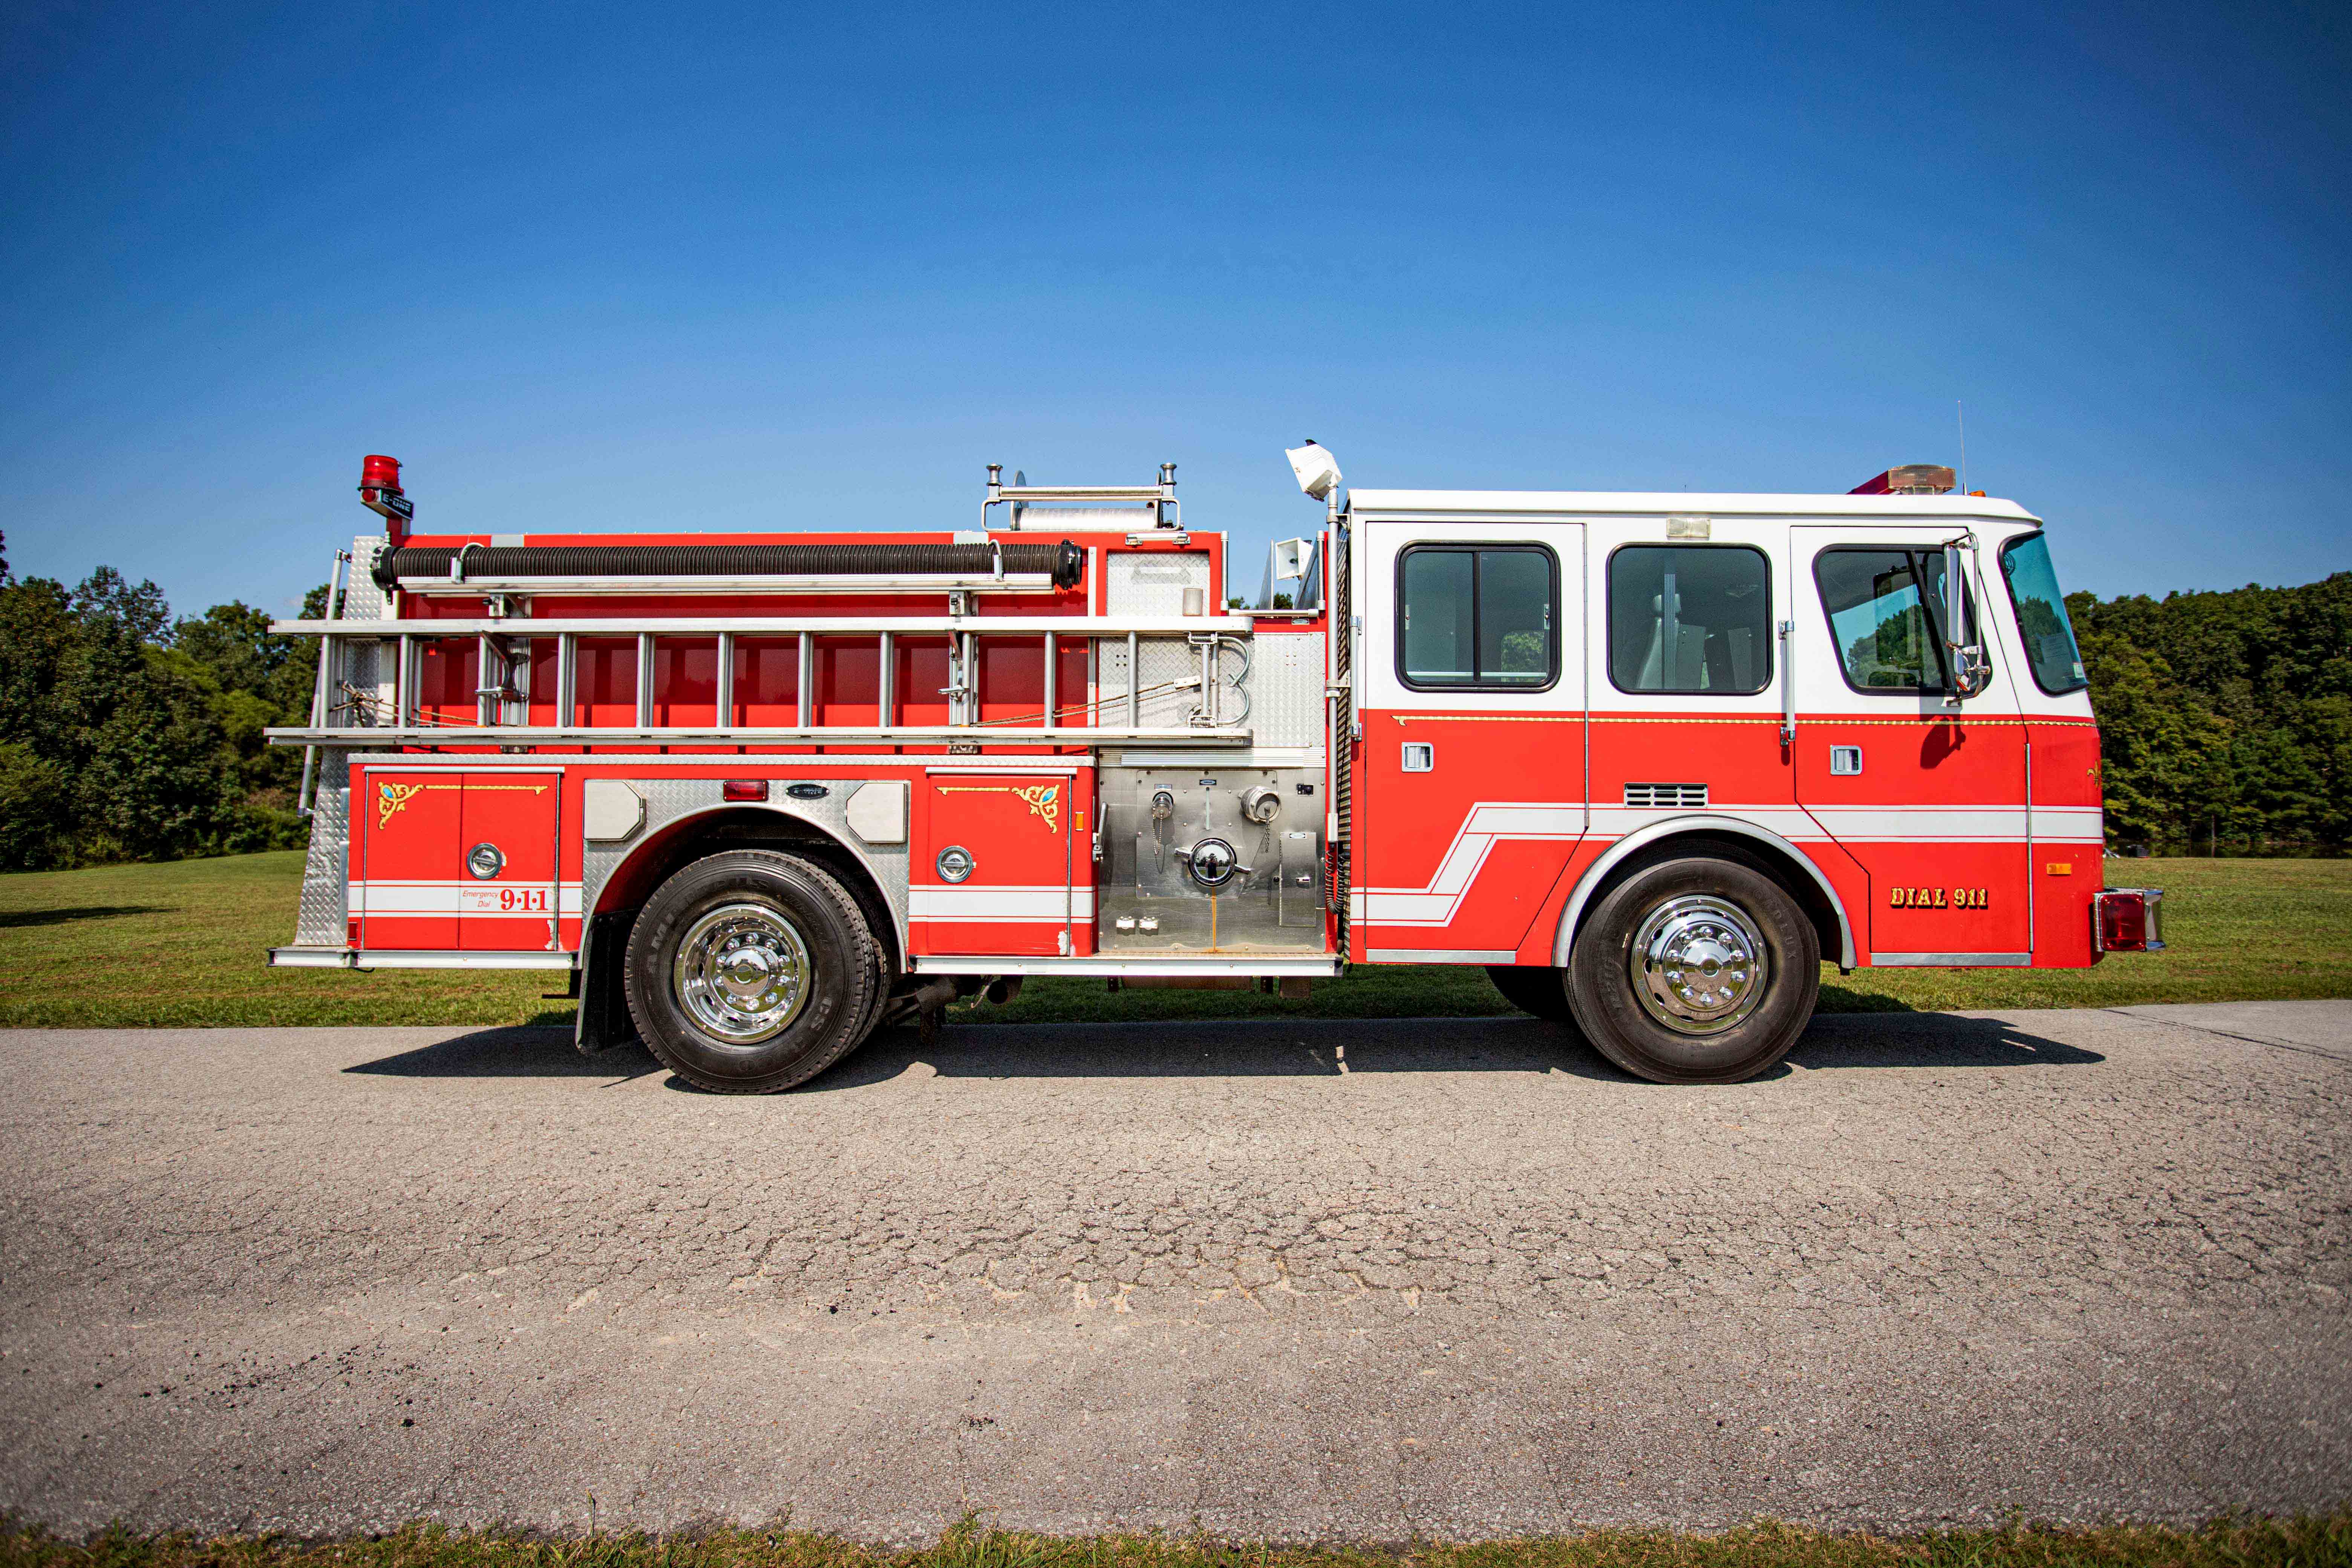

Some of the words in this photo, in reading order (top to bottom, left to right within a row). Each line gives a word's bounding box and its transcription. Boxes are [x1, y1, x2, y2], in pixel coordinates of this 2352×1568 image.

[383, 493, 410, 512] E-ONE
[462, 890, 498, 899] Emergency
[1890, 887, 1948, 909] DIAL
[1953, 888, 1988, 910] 911
